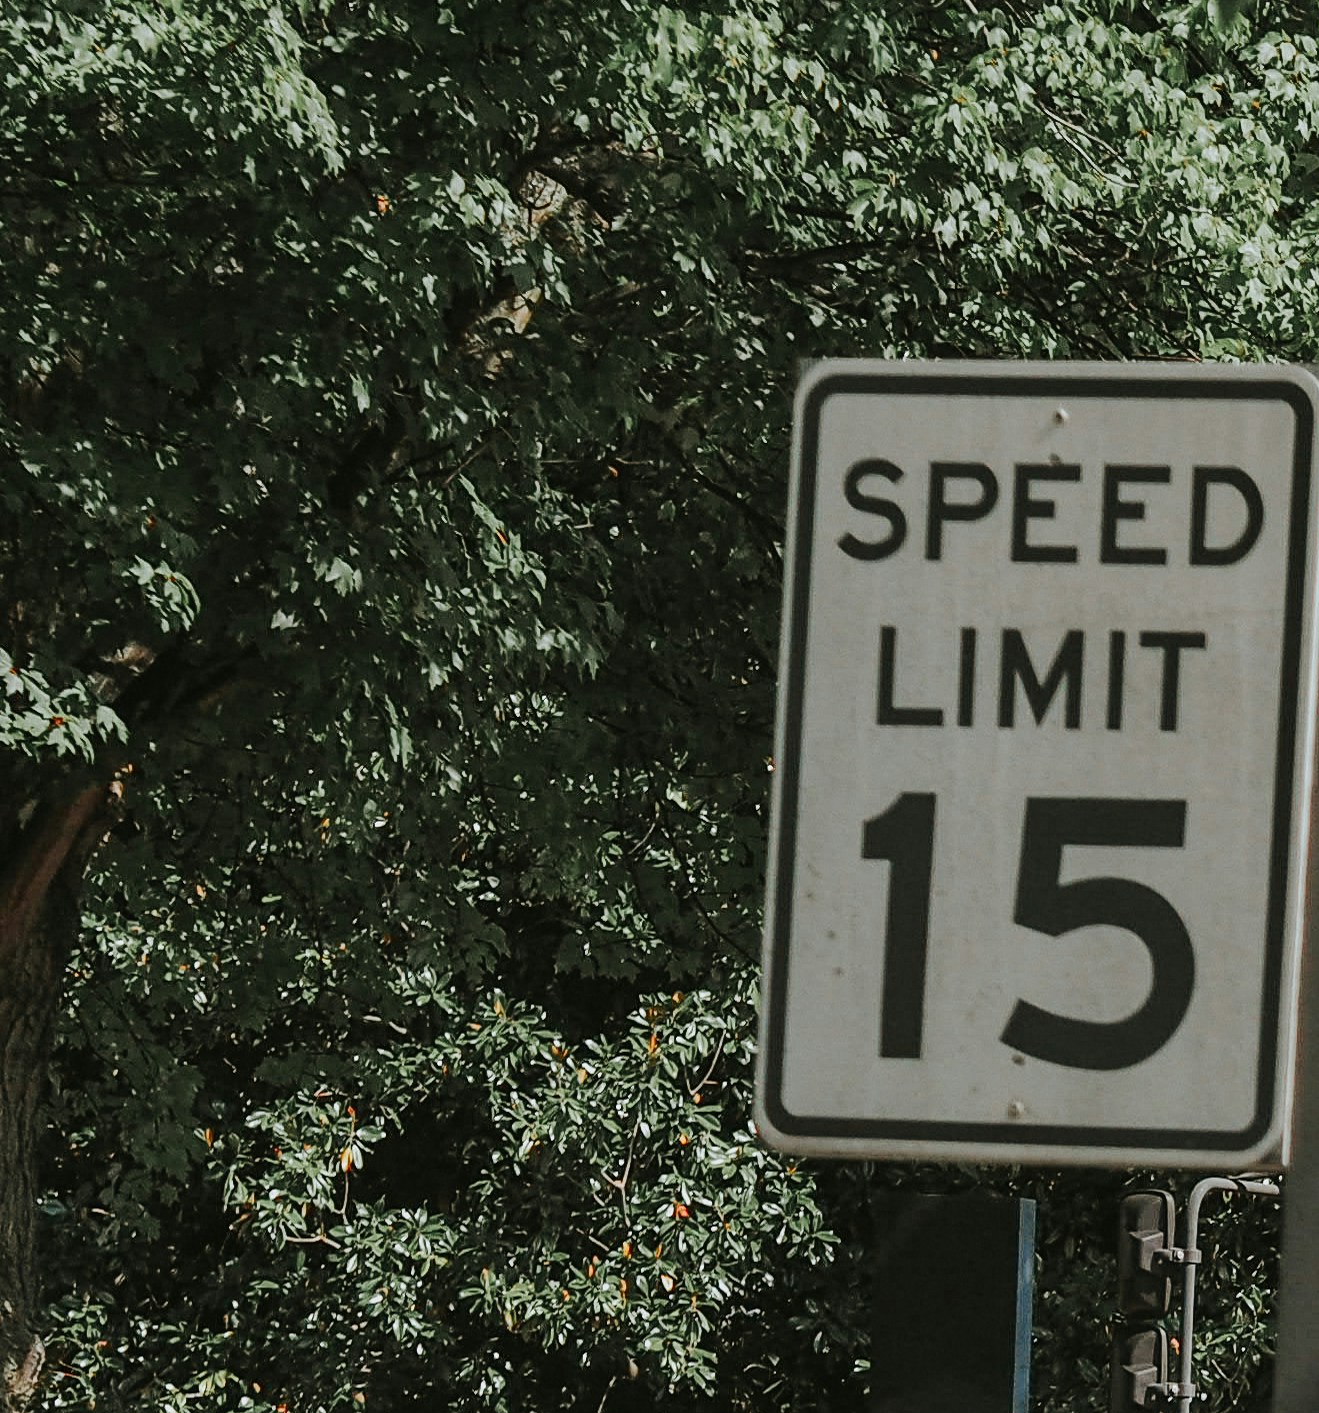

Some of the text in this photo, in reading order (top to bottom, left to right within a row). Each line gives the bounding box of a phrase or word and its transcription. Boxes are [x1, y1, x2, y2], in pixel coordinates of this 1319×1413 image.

[837, 458, 1265, 566] SPEED
[876, 626, 1206, 732] LIMIT
[861, 791, 1195, 1070] 15
